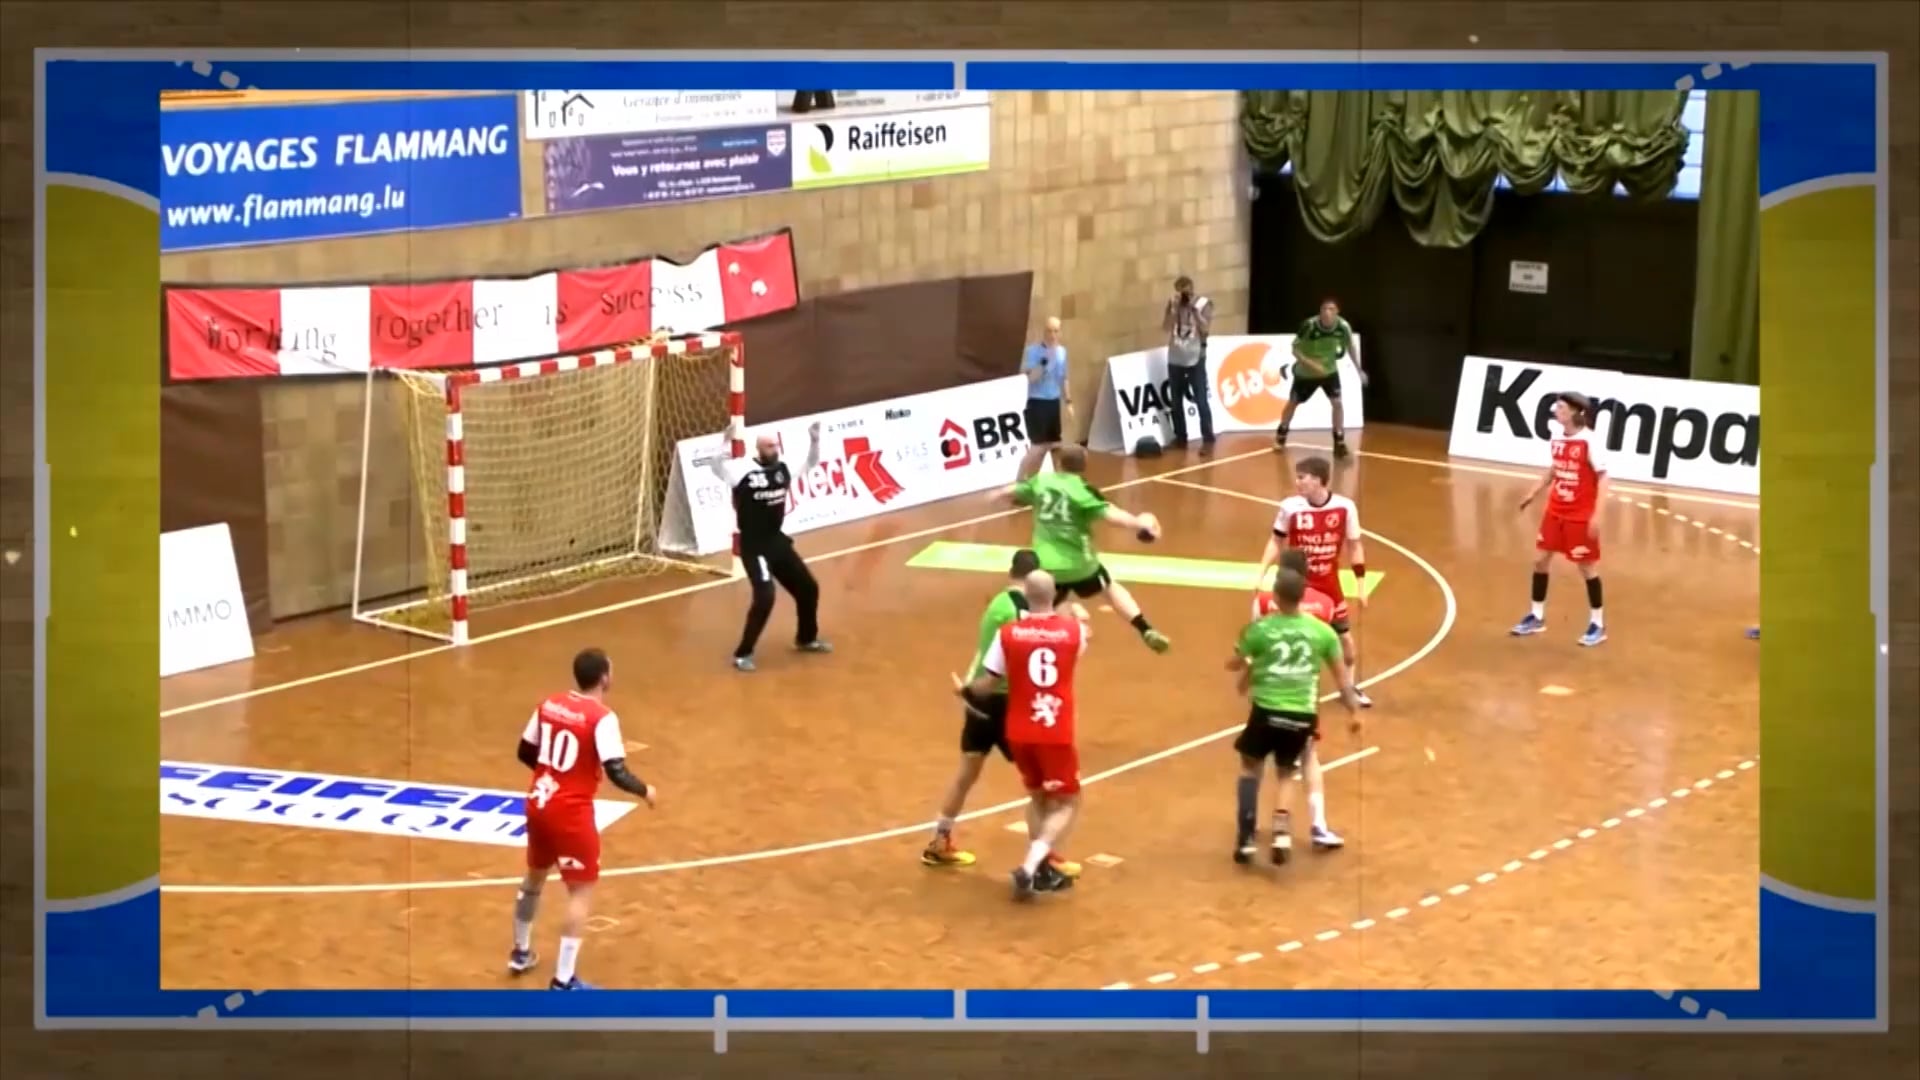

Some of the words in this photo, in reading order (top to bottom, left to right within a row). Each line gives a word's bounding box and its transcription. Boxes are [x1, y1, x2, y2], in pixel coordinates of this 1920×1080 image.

[161, 136, 319, 177] VOYAGES
[335, 124, 509, 166] FLAMMANG
[848, 120, 947, 151] Raiffeisen
[611, 164, 639, 178] Vous
[703, 157, 727, 170] avec
[167, 184, 406, 228] www.flammang.lu
[601, 282, 703, 316] succss
[1038, 489, 1073, 523] 24
[1296, 512, 1314, 530] 13
[167, 599, 232, 631] IMMO
[1027, 646, 1059, 689] 6
[1266, 639, 1314, 675] 22
[537, 719, 580, 774] 10
